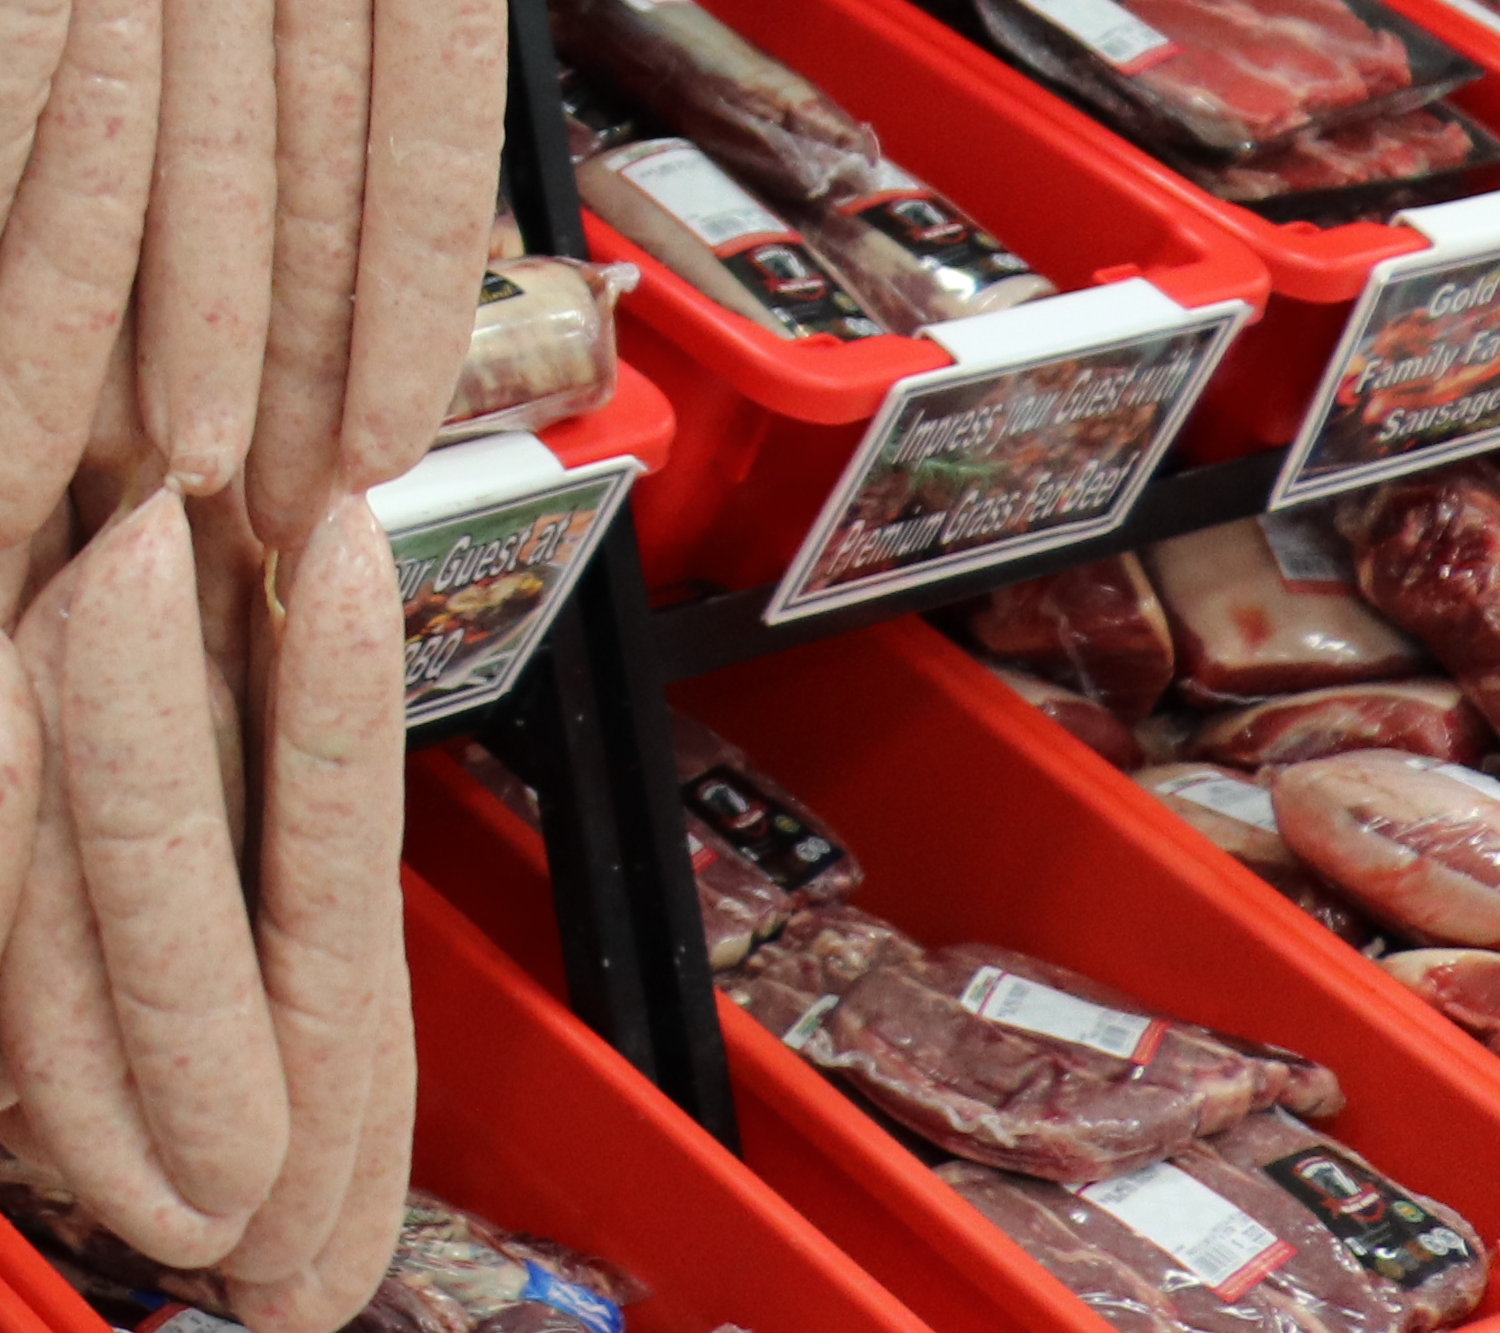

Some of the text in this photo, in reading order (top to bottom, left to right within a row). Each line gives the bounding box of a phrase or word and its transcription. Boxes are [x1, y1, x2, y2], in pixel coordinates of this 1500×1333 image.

[893, 348, 1194, 470] Impress your Guest with
[1354, 341, 1461, 394] Family
[433, 521, 538, 593] Guest
[527, 504, 579, 567] at
[827, 450, 1140, 577] Premium Grass Fed Beef
